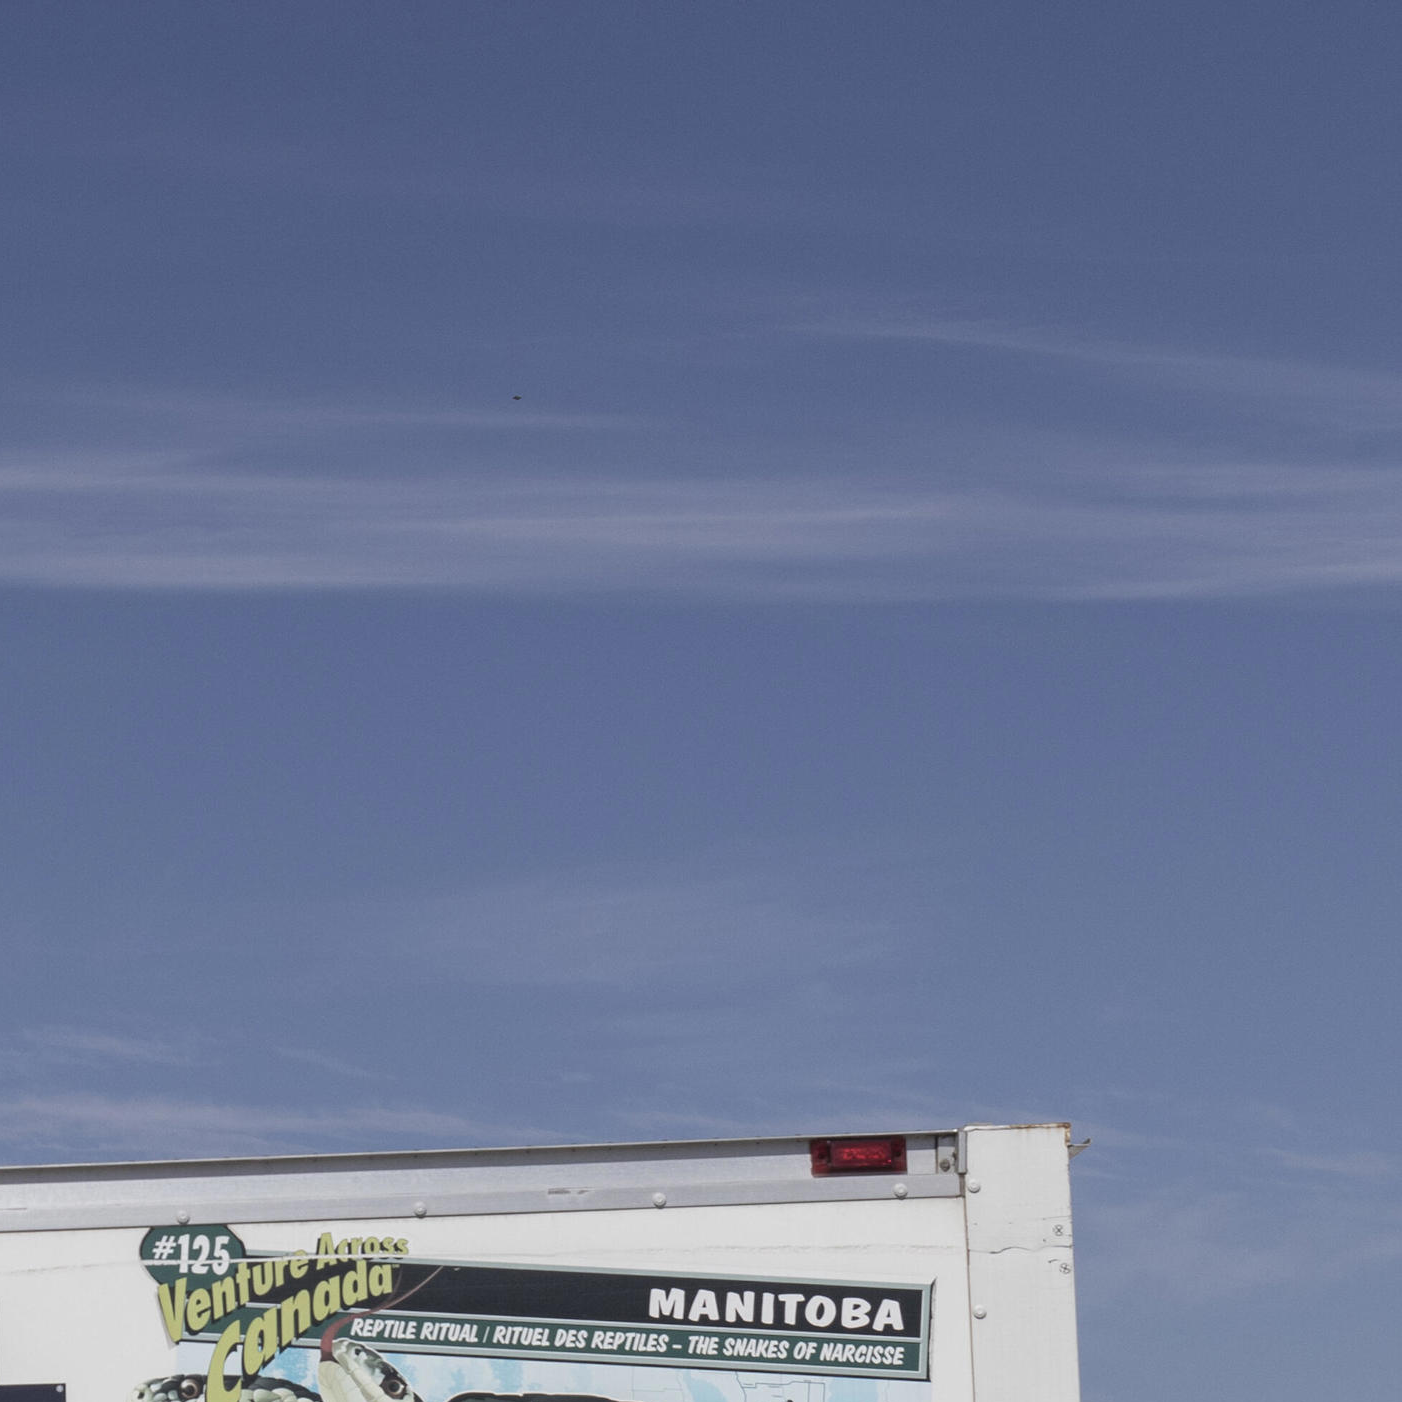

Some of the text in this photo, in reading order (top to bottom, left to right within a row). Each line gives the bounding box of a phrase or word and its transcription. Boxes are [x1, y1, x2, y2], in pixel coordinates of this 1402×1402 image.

[151, 1232, 231, 1277] #125
[157, 1232, 410, 1343] Venture Across
[648, 1287, 905, 1332] MANITOBA
[349, 1317, 905, 1365] REPTILE RITUAL RITUEL DES REPTILES THE SNAKES OF NARCISSE
